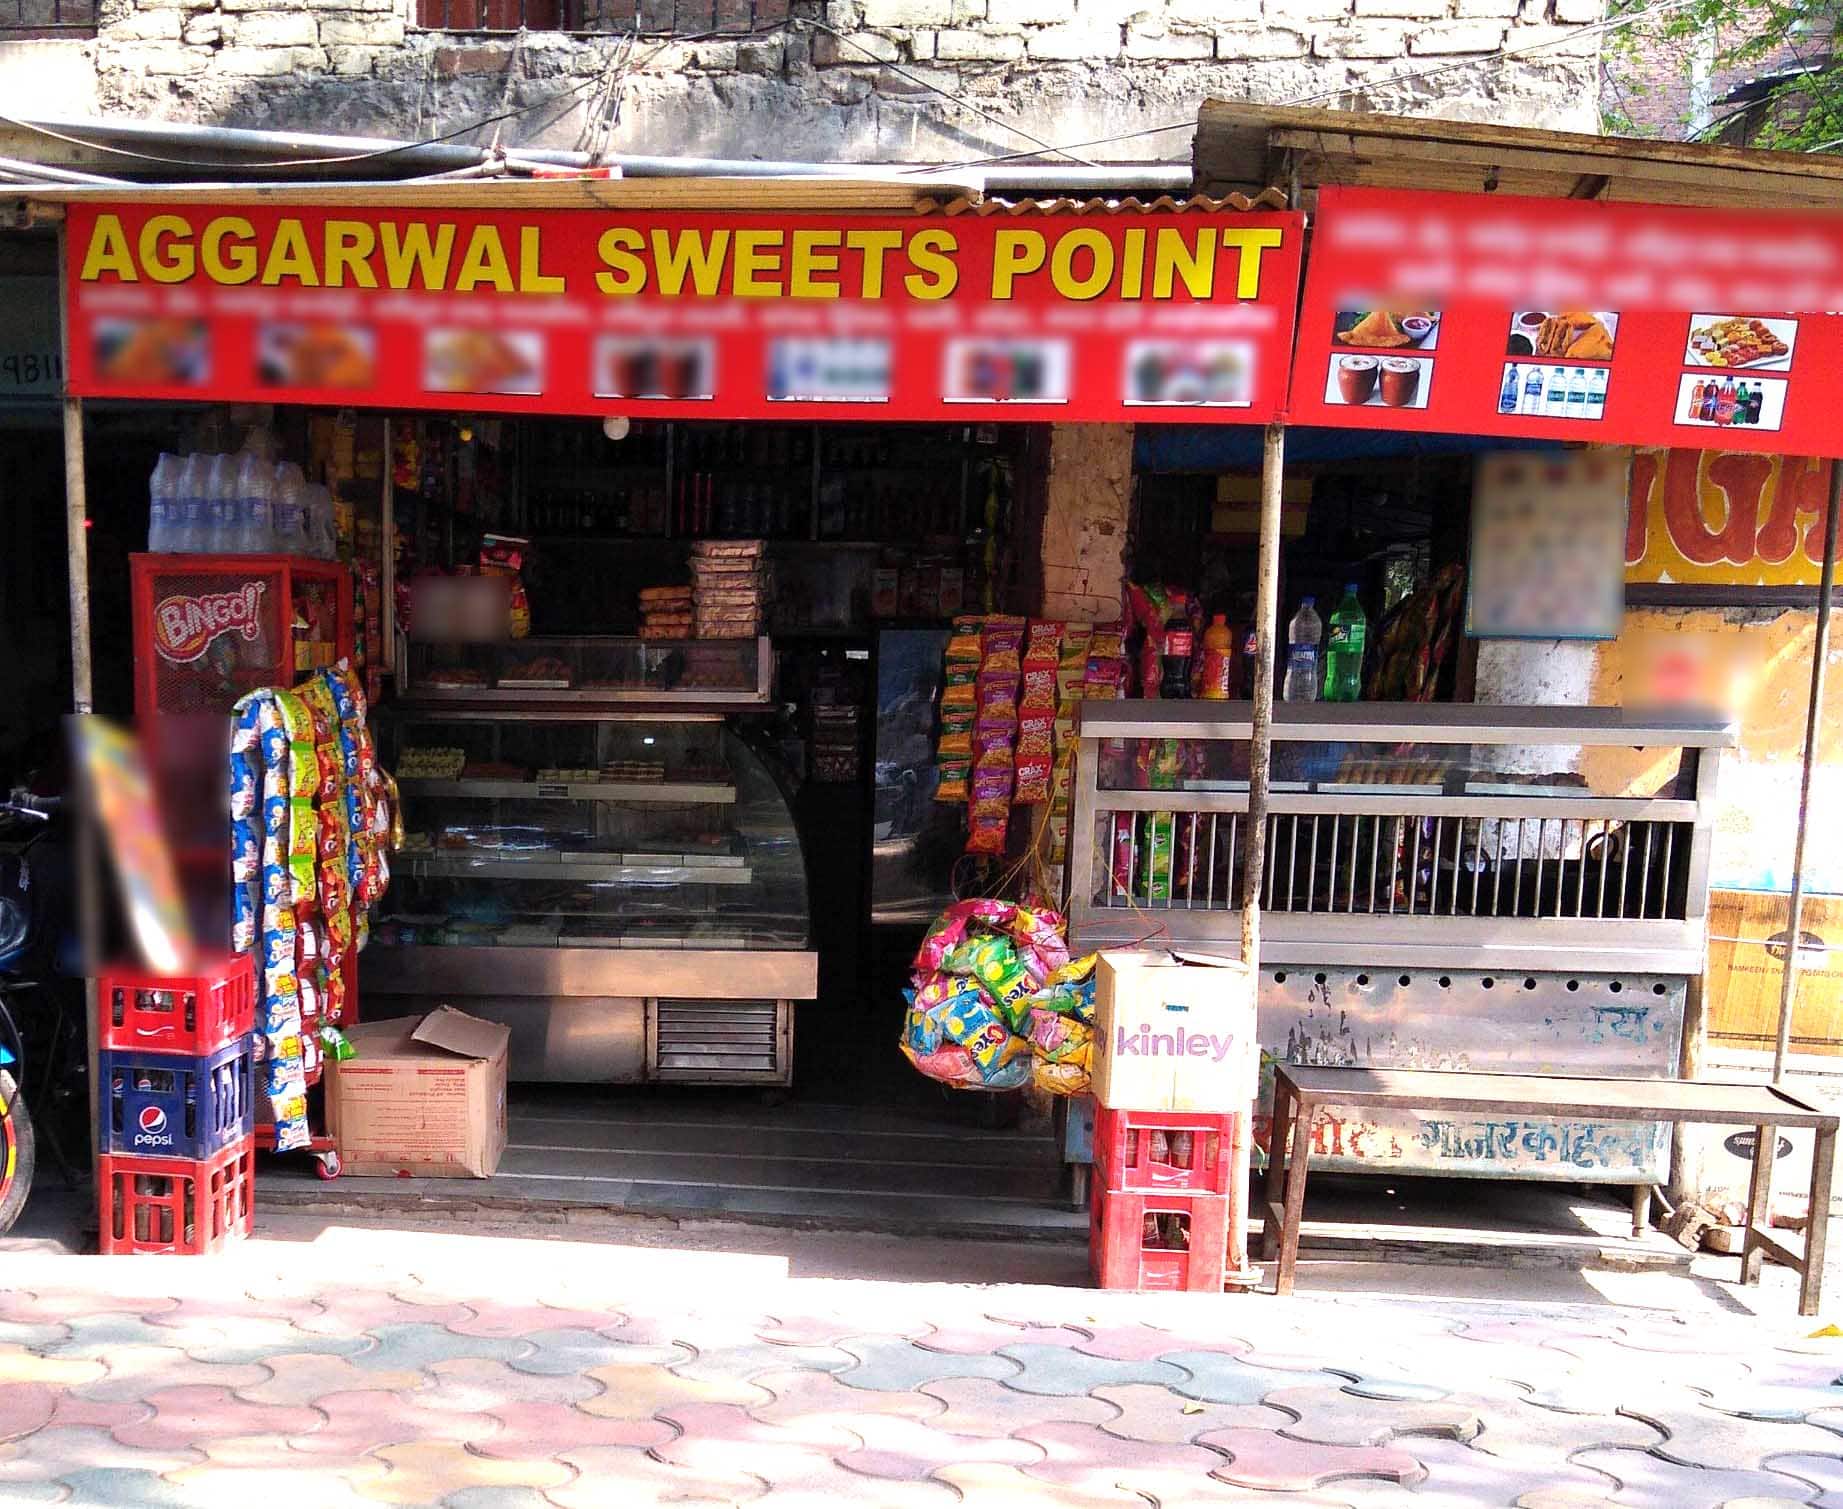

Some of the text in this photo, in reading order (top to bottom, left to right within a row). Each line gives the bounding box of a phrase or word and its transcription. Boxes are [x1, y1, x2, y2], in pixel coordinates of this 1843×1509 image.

[80, 213, 567, 294] AGGARWAL
[595, 226, 959, 299] SWEETS
[991, 227, 1284, 300] POINT
[1116, 1023, 1234, 1062] kinley
[134, 1133, 174, 1147] pepsi
